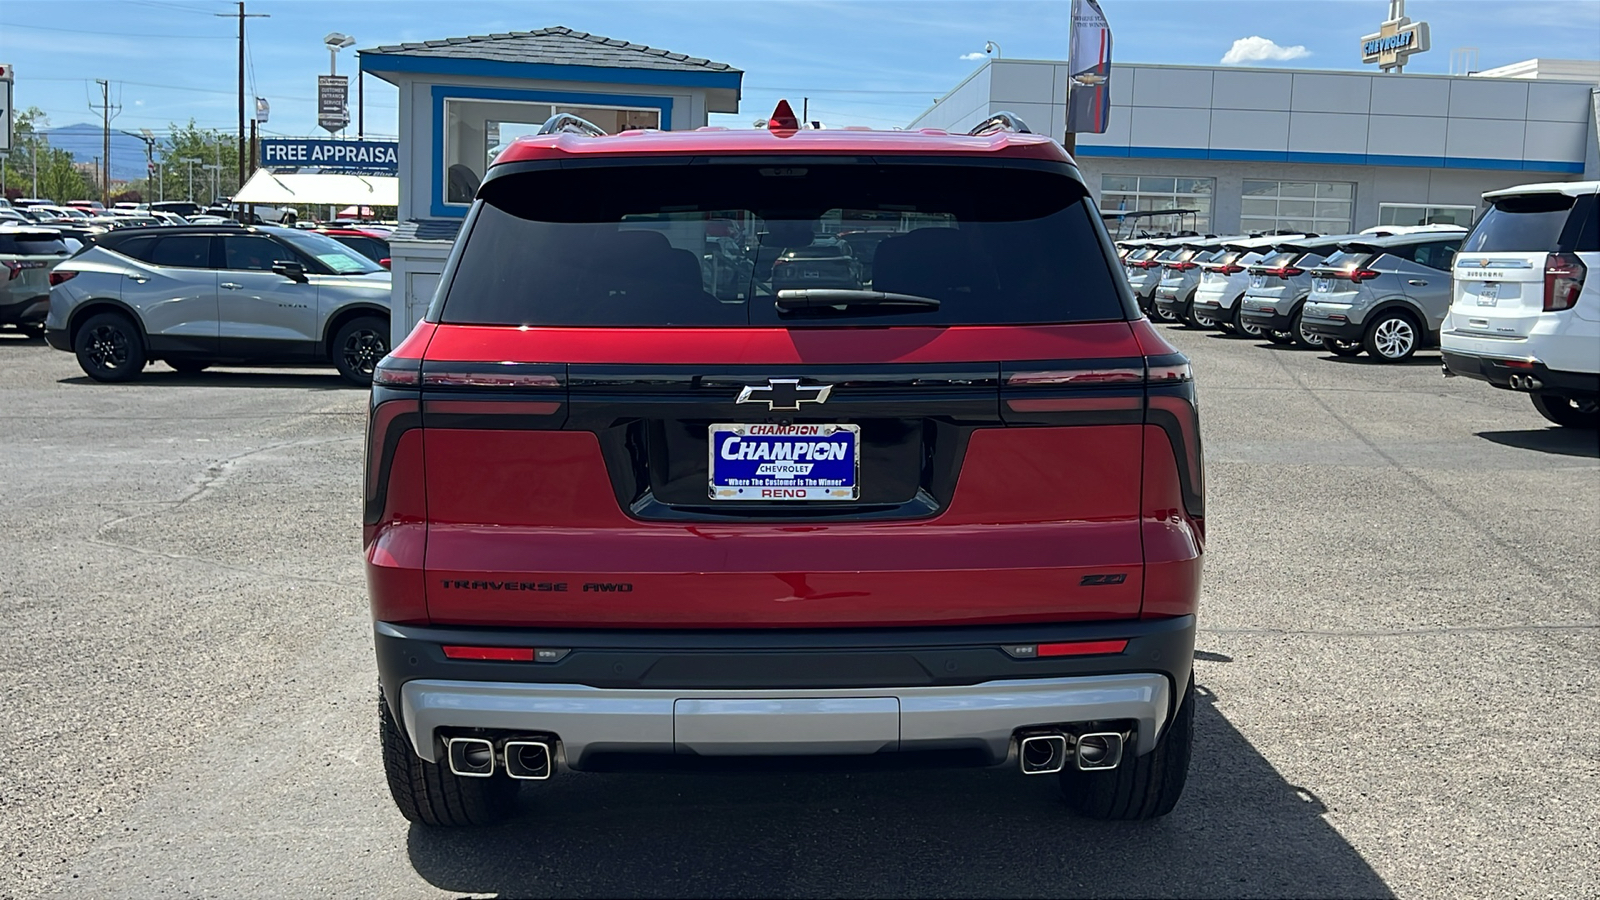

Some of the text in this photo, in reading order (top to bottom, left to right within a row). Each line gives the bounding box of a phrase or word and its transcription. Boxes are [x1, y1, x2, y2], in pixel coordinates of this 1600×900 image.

[1364, 31, 1413, 55] CHEVROLET
[266, 145, 398, 163] FREE APPRAISA
[750, 425, 819, 435] CHAMPION
[760, 465, 809, 473] CHEVROLET
[751, 478, 764, 486] The
[765, 478, 796, 486] Customer
[797, 478, 804, 486] Is
[805, 478, 817, 486] The
[761, 489, 807, 498] RENO
[440, 579, 634, 592] TRAVERSE AWD
